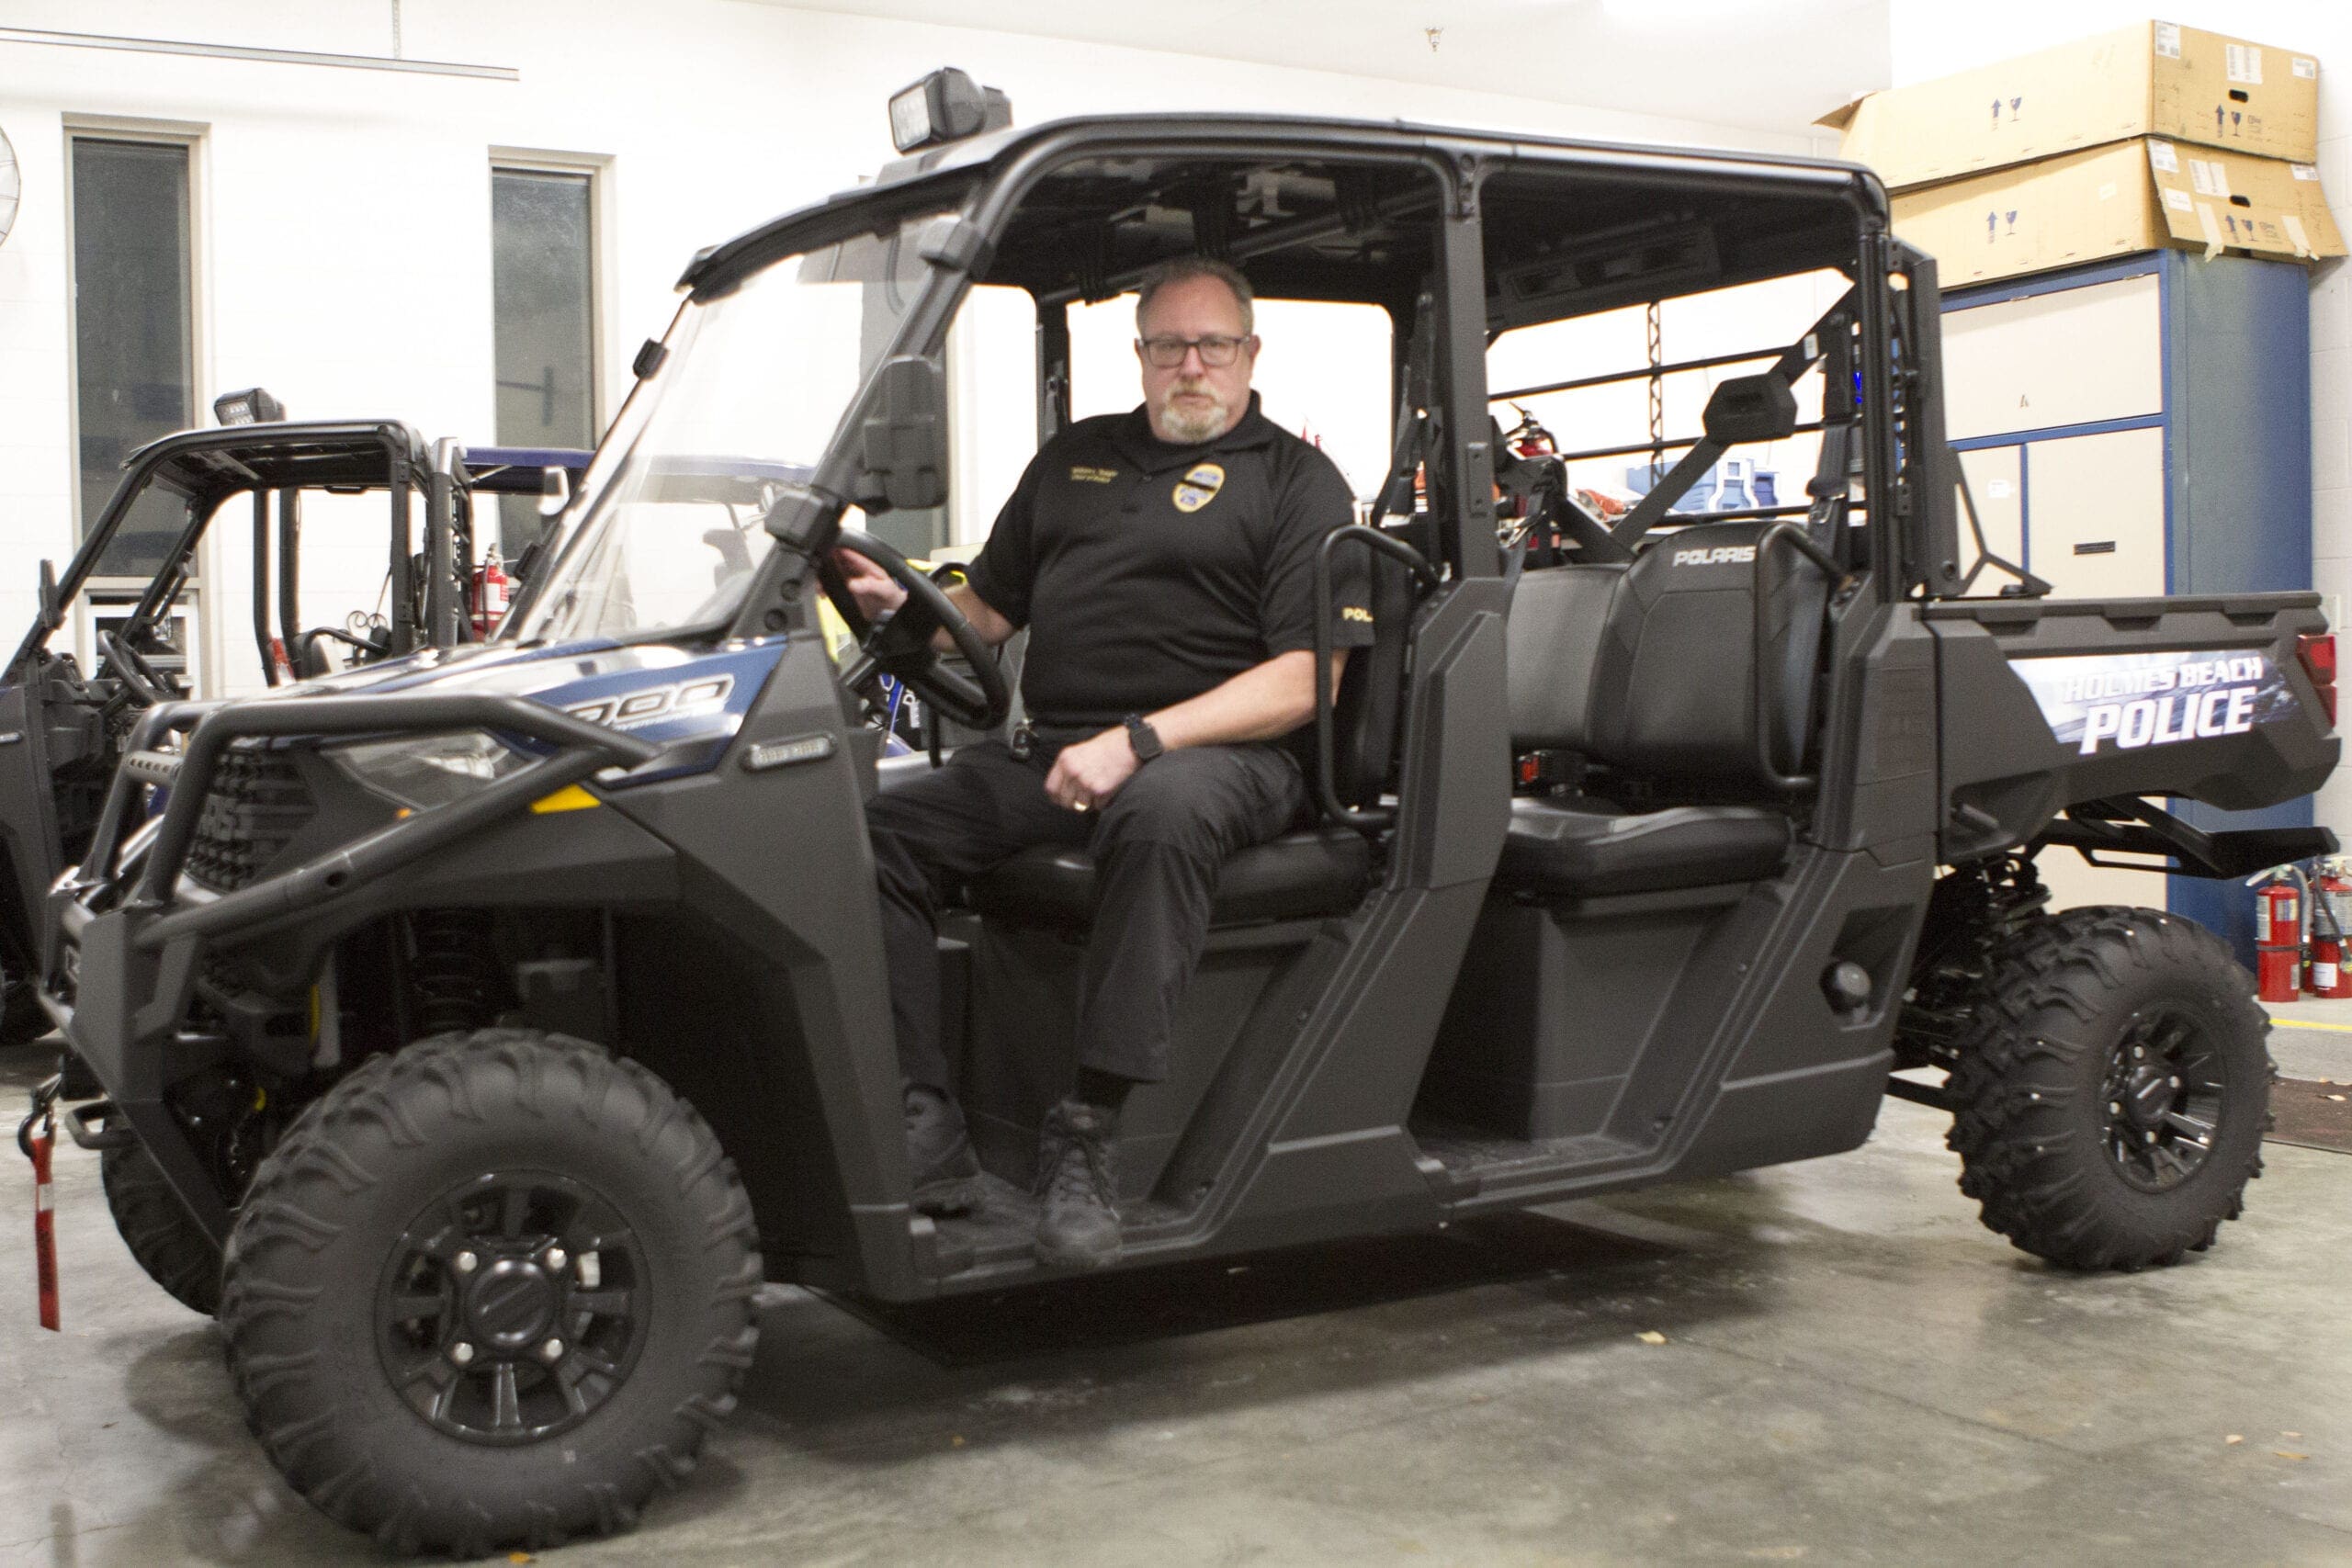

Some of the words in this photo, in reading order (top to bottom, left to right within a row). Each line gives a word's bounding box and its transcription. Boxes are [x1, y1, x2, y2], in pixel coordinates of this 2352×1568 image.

[1672, 546, 1757, 567] POLARIS
[2064, 666, 2177, 705] HOLMES
[2178, 657, 2264, 688] BEACH
[2078, 686, 2258, 756] POLICE
